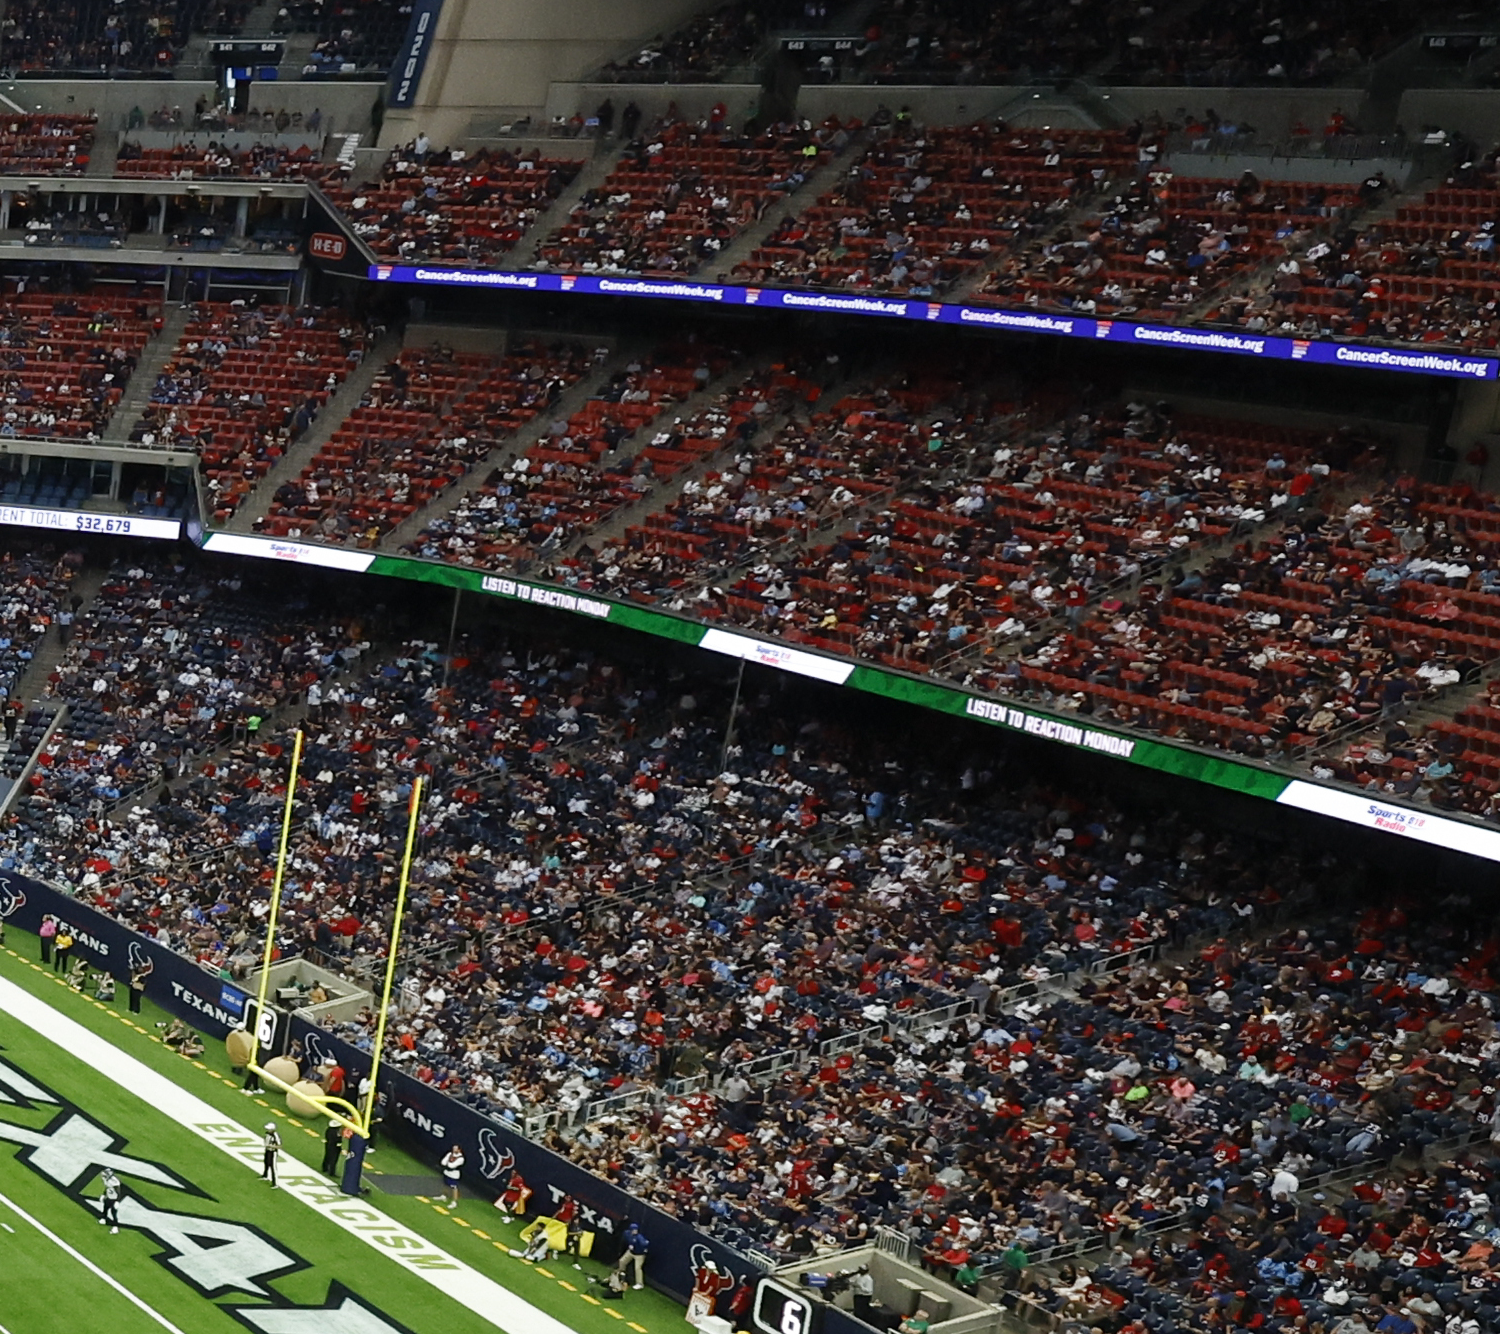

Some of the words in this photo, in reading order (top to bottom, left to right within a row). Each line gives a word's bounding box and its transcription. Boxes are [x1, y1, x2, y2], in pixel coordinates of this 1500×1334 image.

[1135, 326, 1265, 355] CancerScreenWeek.org
[1336, 345, 1488, 377] CancerScreenWeek.org
[76, 513, 132, 534] $32,679
[965, 696, 1006, 720] LISTEN
[1007, 707, 1023, 727] TO
[1024, 711, 1083, 745] REACTION
[1084, 726, 1135, 759] MONDAY
[192, 1121, 286, 1164] END
[278, 1174, 463, 1271] RACISM
